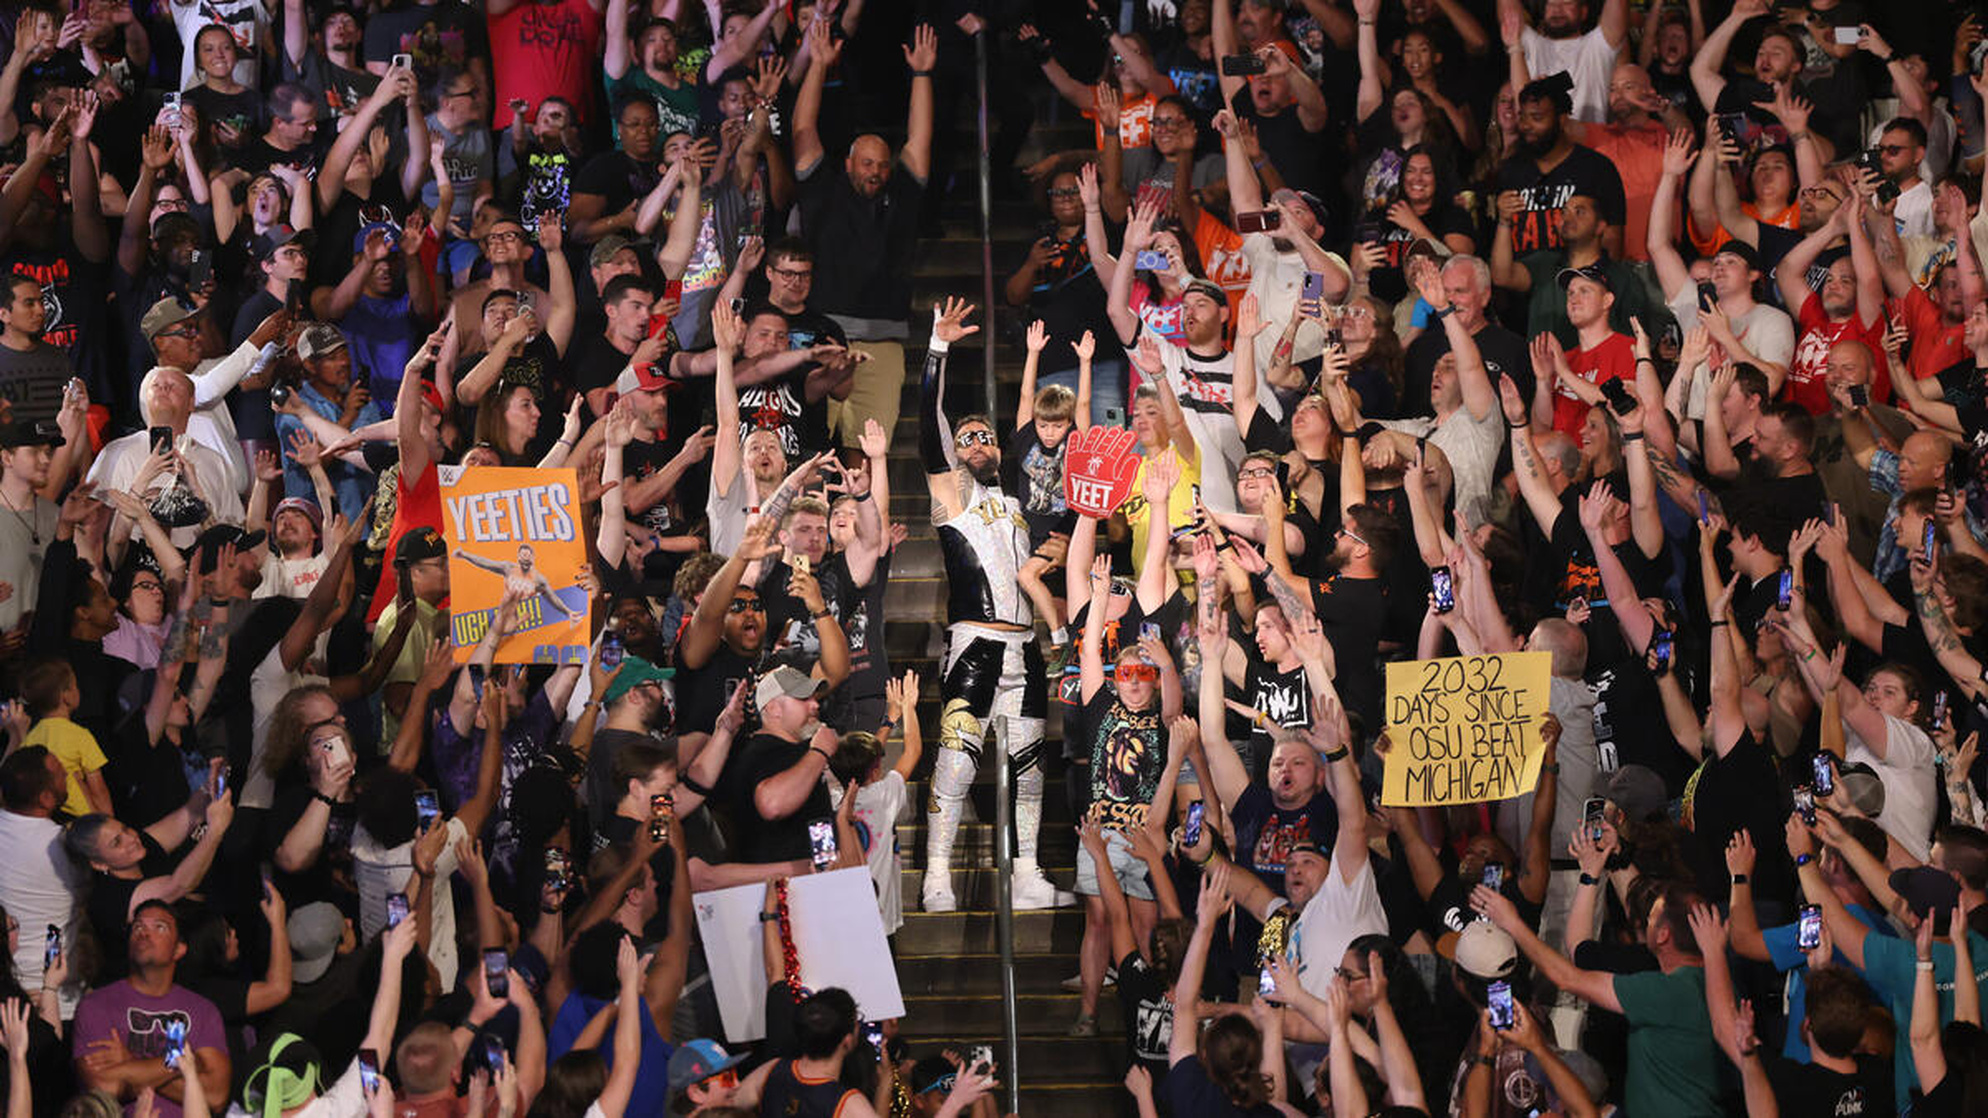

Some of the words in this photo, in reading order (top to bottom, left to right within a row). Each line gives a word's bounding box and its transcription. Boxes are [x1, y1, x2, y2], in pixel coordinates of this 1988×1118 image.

[1070, 475, 1114, 509] YEET
[446, 482, 576, 543] YEETIES
[454, 609, 490, 646] UGH
[1421, 655, 1506, 694] 2032
[1392, 690, 1450, 725] DAYS
[1464, 689, 1531, 723] SINCE
[1409, 723, 1463, 761] OSU
[1470, 719, 1532, 759] BEAT
[1405, 755, 1527, 803] MICHIGAN
